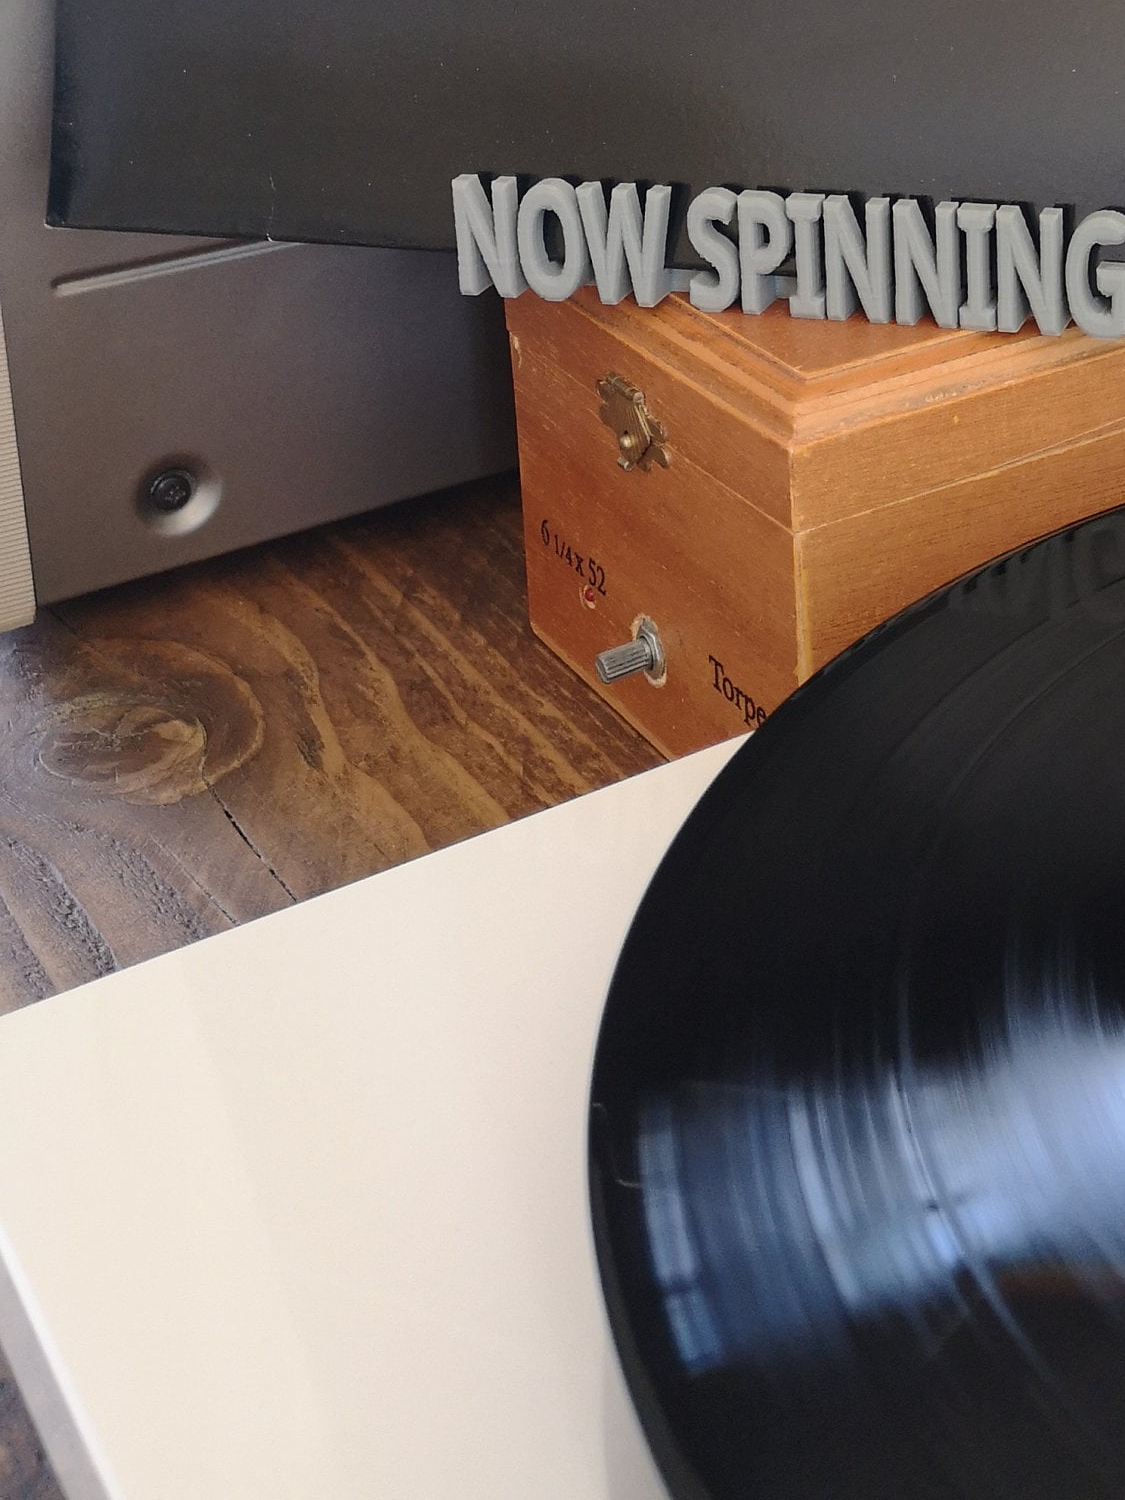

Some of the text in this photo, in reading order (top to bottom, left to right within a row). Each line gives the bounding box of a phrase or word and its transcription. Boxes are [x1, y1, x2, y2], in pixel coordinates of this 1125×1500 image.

[452, 174, 671, 308] NOW
[541, 519, 550, 546] 6
[588, 558, 607, 596] 52
